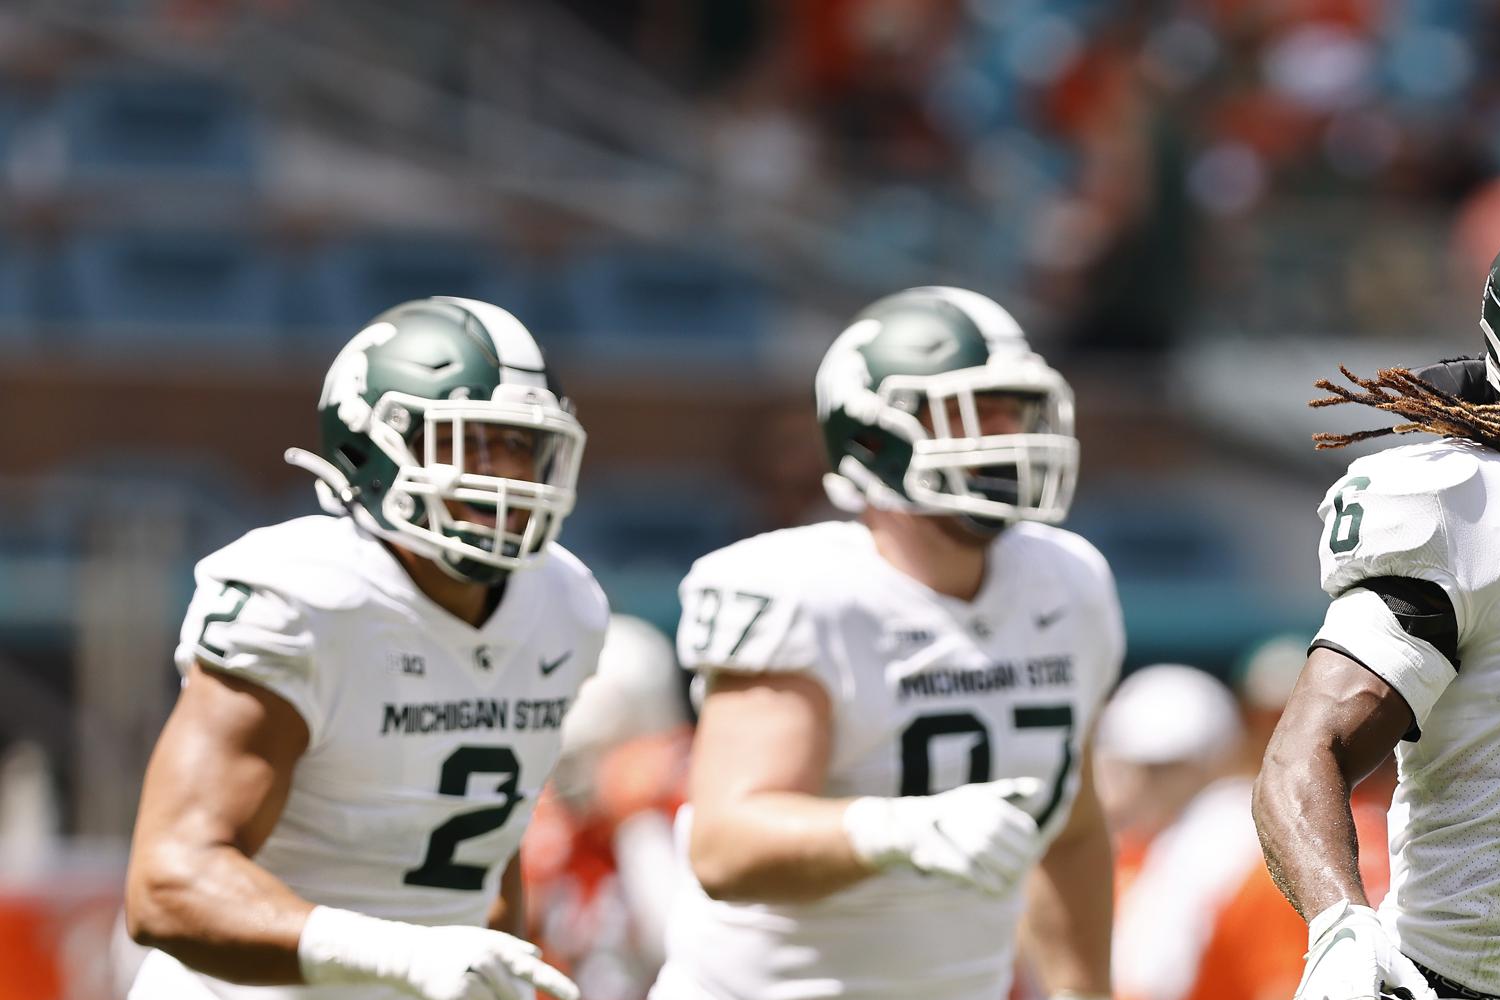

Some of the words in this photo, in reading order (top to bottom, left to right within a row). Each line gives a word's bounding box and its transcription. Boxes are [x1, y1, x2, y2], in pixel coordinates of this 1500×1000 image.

[1329, 476, 1371, 554] 6
[197, 580, 252, 658] 2
[381, 697, 508, 735] MICHIGAN
[404, 746, 521, 890] 2
